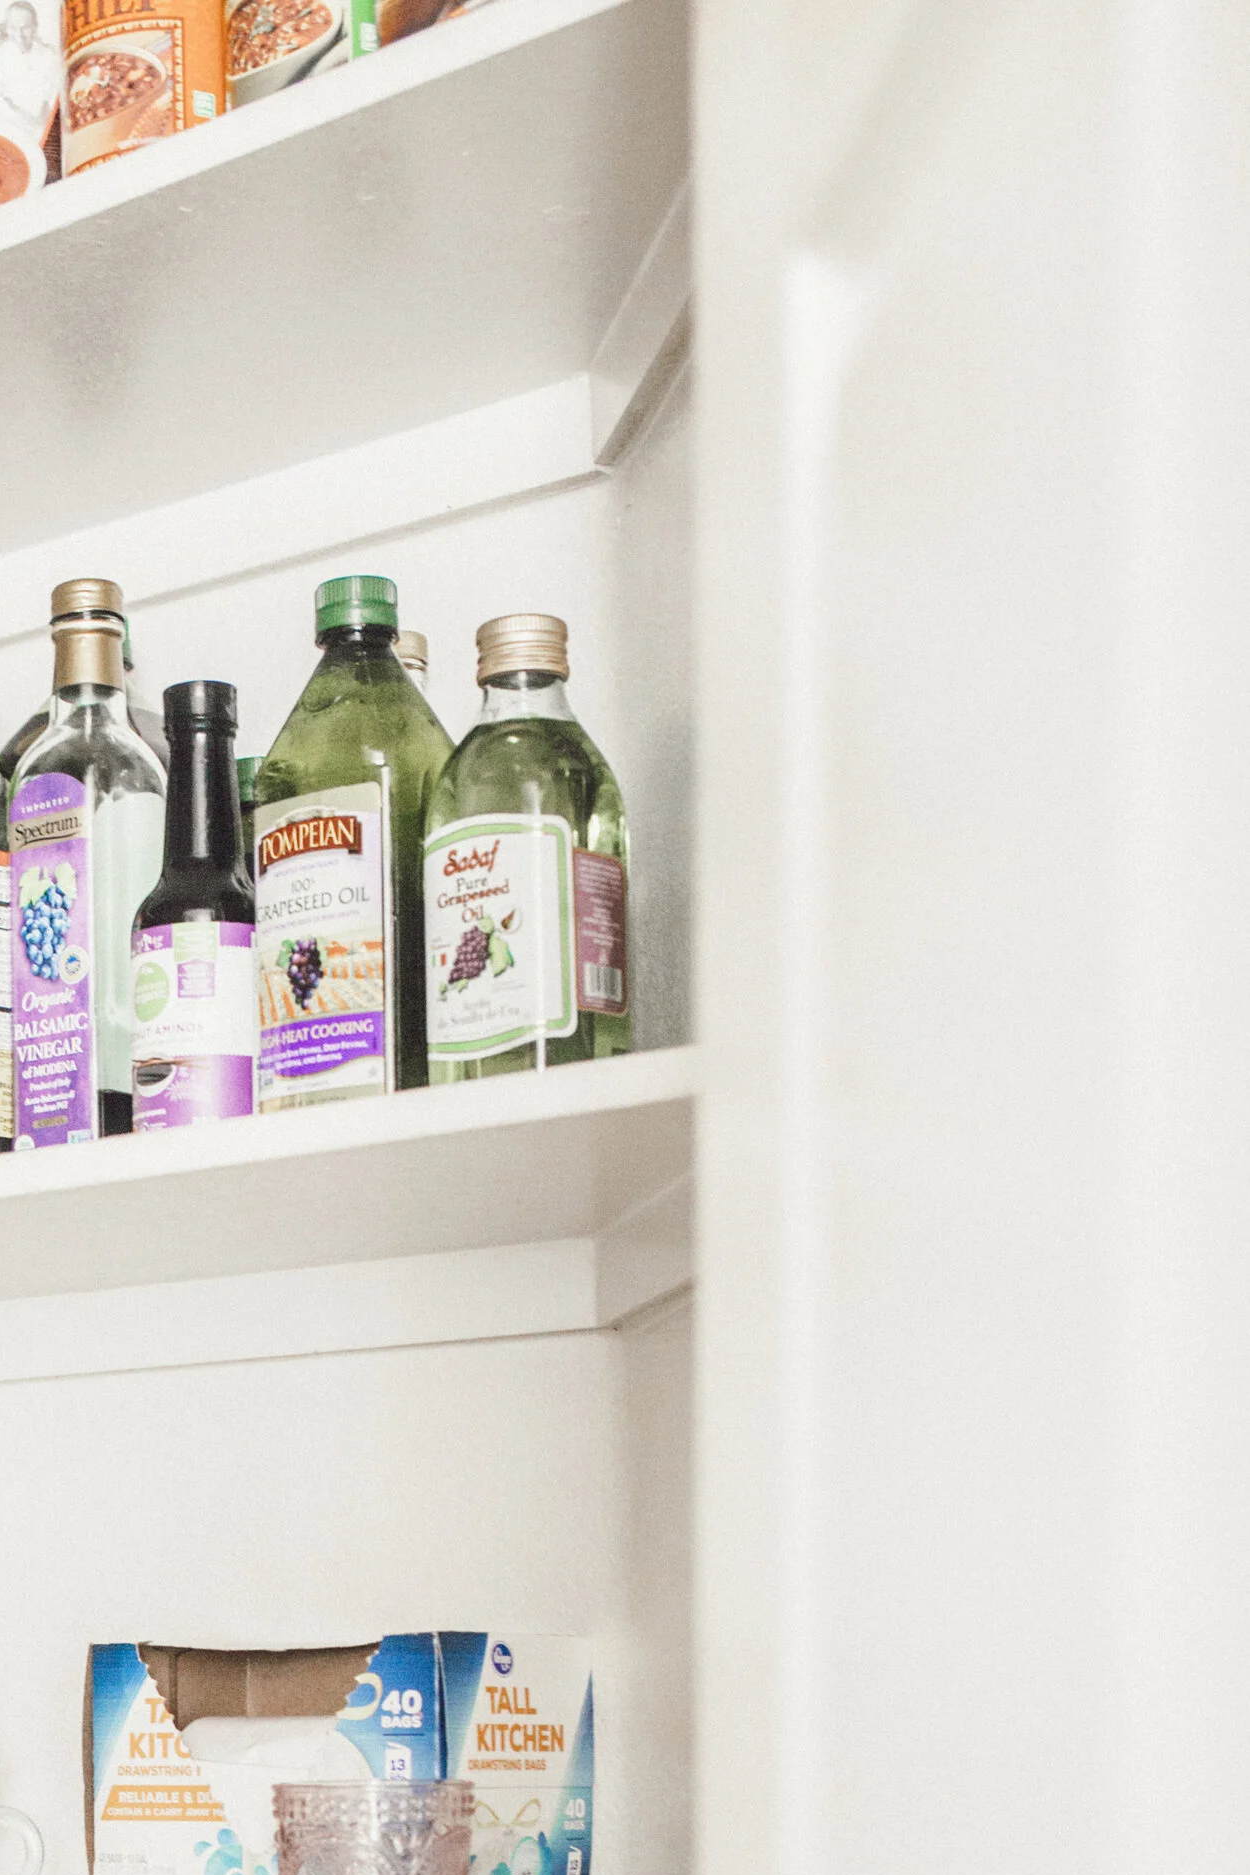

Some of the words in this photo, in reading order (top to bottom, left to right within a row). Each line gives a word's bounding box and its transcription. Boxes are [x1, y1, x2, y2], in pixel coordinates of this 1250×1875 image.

[15, 816, 79, 845] Spectrum
[262, 818, 354, 865] POMPEIAN
[444, 840, 500, 876] Sadaf
[438, 878, 511, 909] Grapeseed
[456, 876, 488, 893] Pure
[255, 891, 333, 923] GRAPESEED
[338, 886, 371, 905] OIL
[462, 905, 485, 923] Oil
[22, 988, 77, 1013] Organic
[14, 1012, 88, 1041] BALSAMIC
[310, 1017, 375, 1040] COOKING
[16, 1036, 84, 1063] VINEGAR
[381, 1689, 423, 1715] 40
[486, 1686, 537, 1716] TALL
[381, 1715, 423, 1729] BAGS
[129, 1732, 192, 1759] KITC
[477, 1724, 565, 1752] KITCHEN
[118, 1765, 193, 1777] DRAWSTRING
[390, 1758, 406, 1771] 13
[468, 1758, 522, 1771] DRAWSTRING
[525, 1758, 547, 1771] BAGS
[119, 1791, 181, 1804] RELIABLE
[564, 1798, 585, 1819] 40
